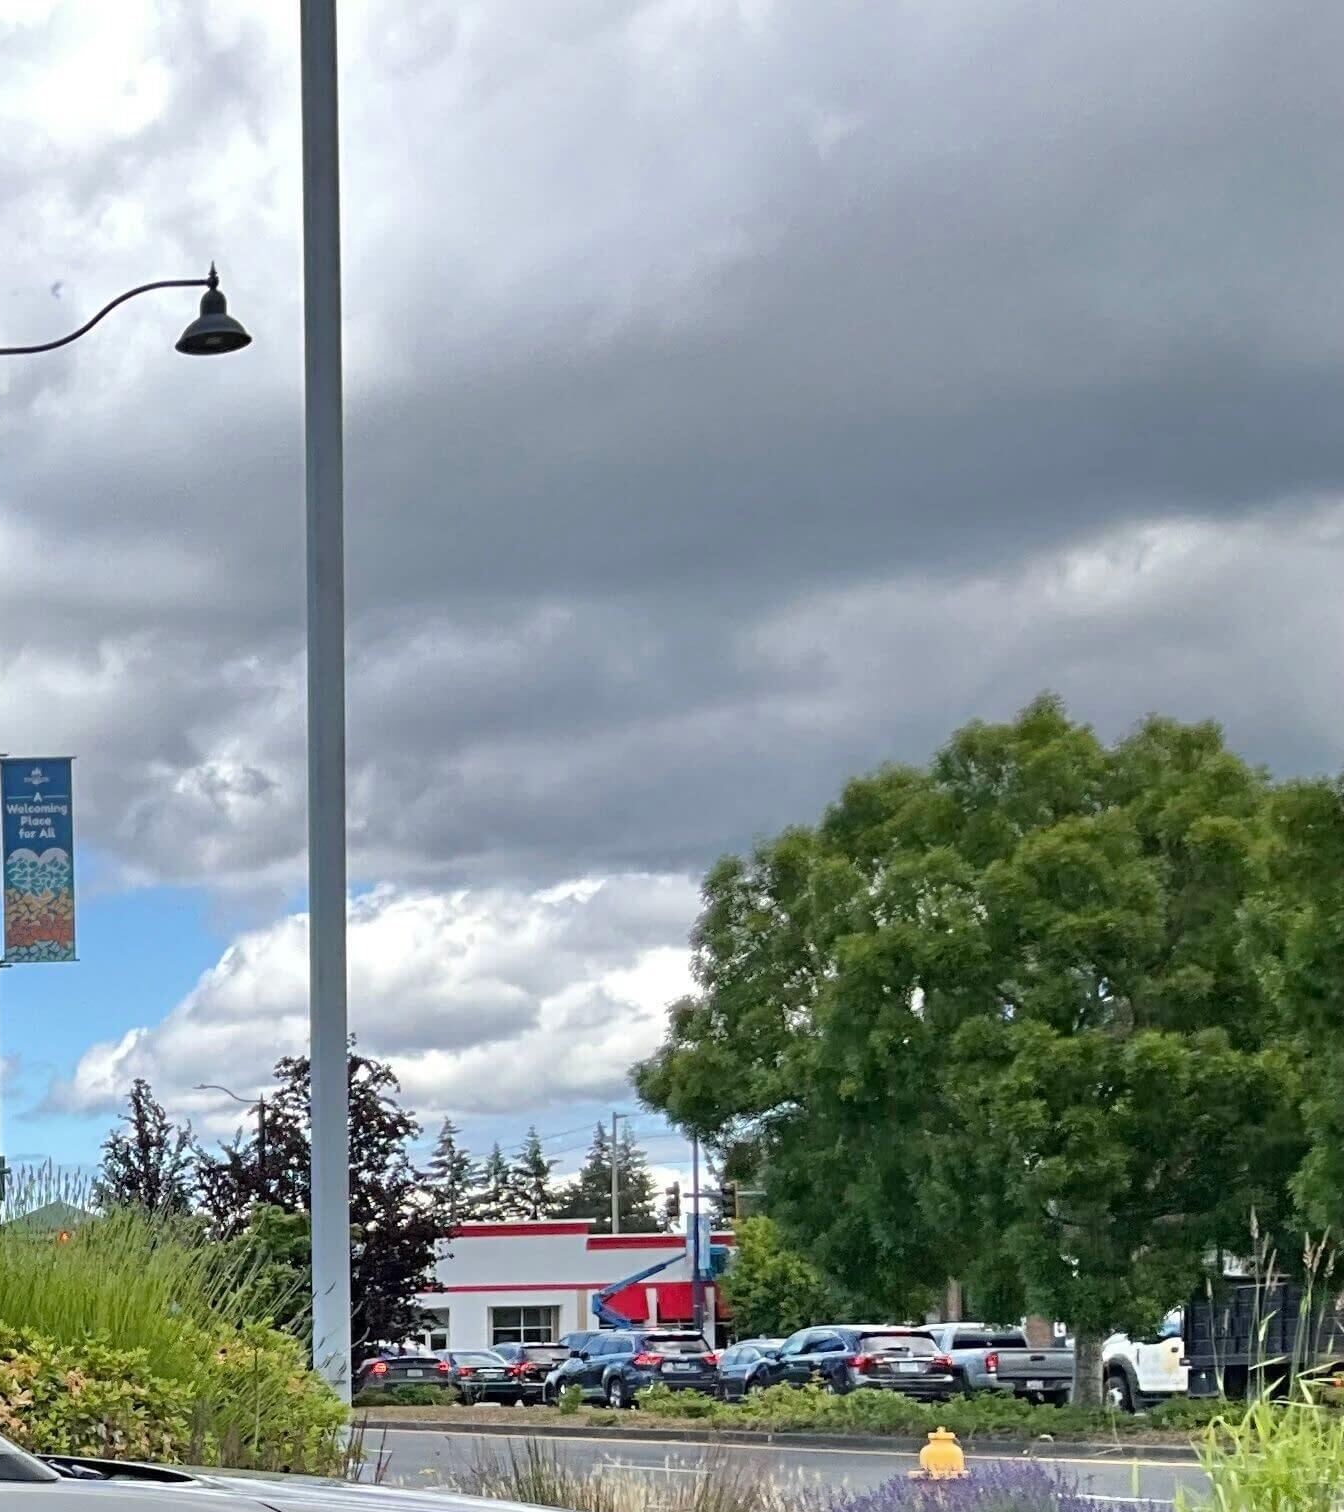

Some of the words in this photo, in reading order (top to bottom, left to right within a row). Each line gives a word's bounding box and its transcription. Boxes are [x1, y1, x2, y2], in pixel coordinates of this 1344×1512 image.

[33, 792, 43, 802] A
[6, 803, 68, 816] Welcoming
[20, 815, 52, 827] Place
[18, 828, 37, 839] for
[39, 826, 56, 839] All
